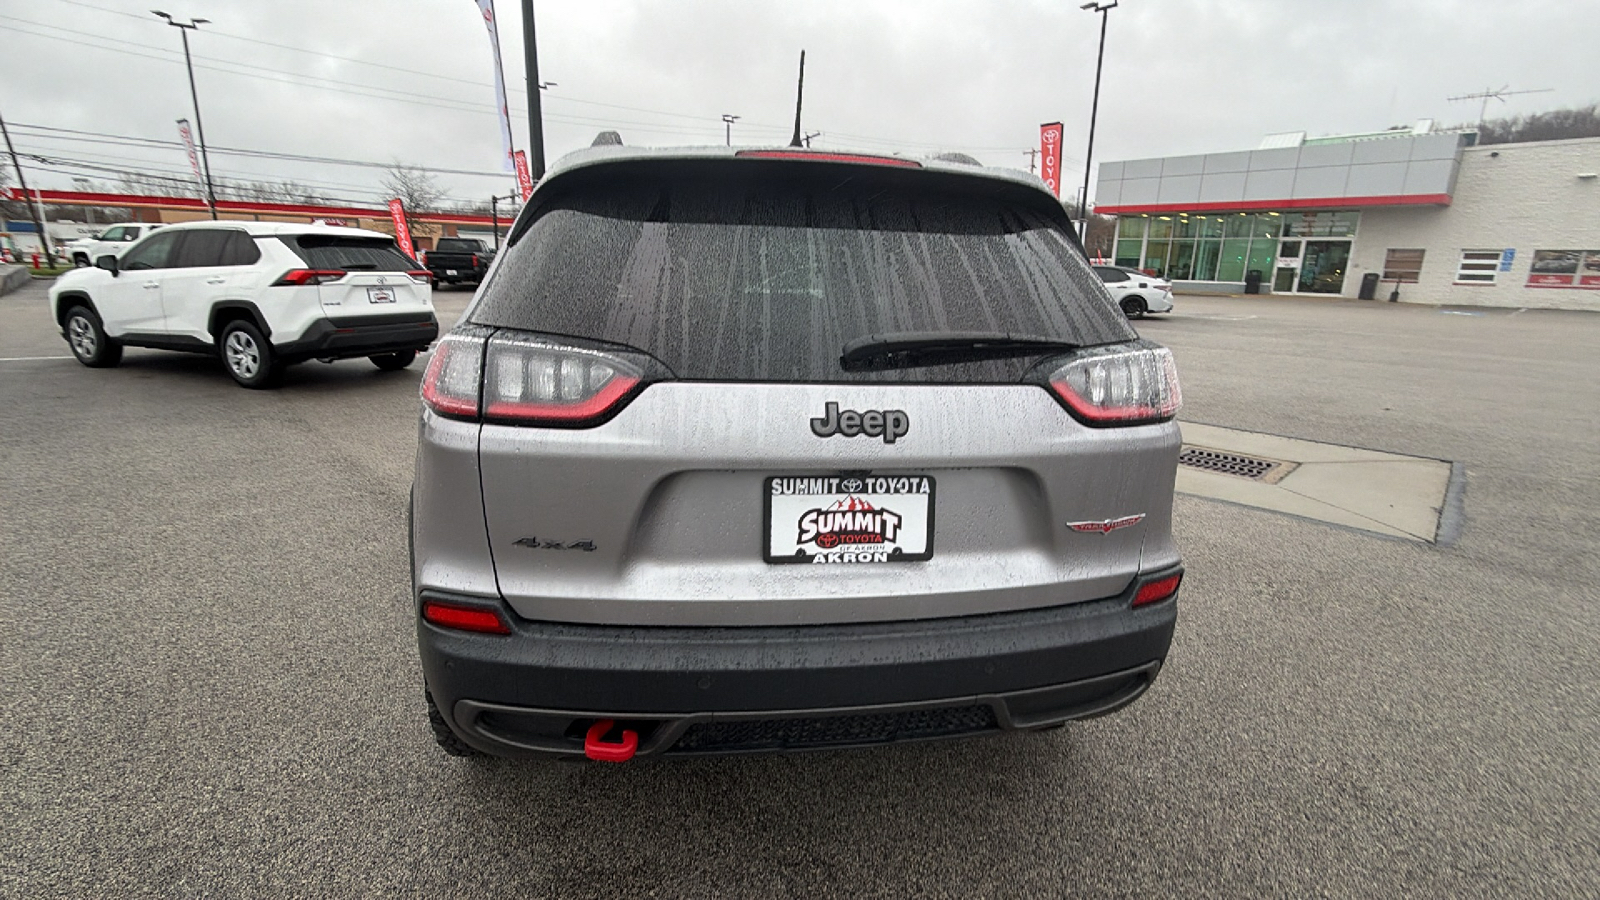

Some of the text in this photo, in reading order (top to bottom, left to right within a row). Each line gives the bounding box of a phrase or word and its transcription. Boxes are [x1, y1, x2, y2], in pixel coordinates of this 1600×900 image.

[1046, 144, 1056, 193] TOYO
[392, 214, 411, 257] TOYOT
[810, 401, 909, 444] Jeep
[771, 477, 930, 495] SUMMIT TOYOTA
[800, 510, 900, 544] SUMMIT
[840, 533, 883, 544] TOYOTA
[812, 552, 888, 563] AKRON
